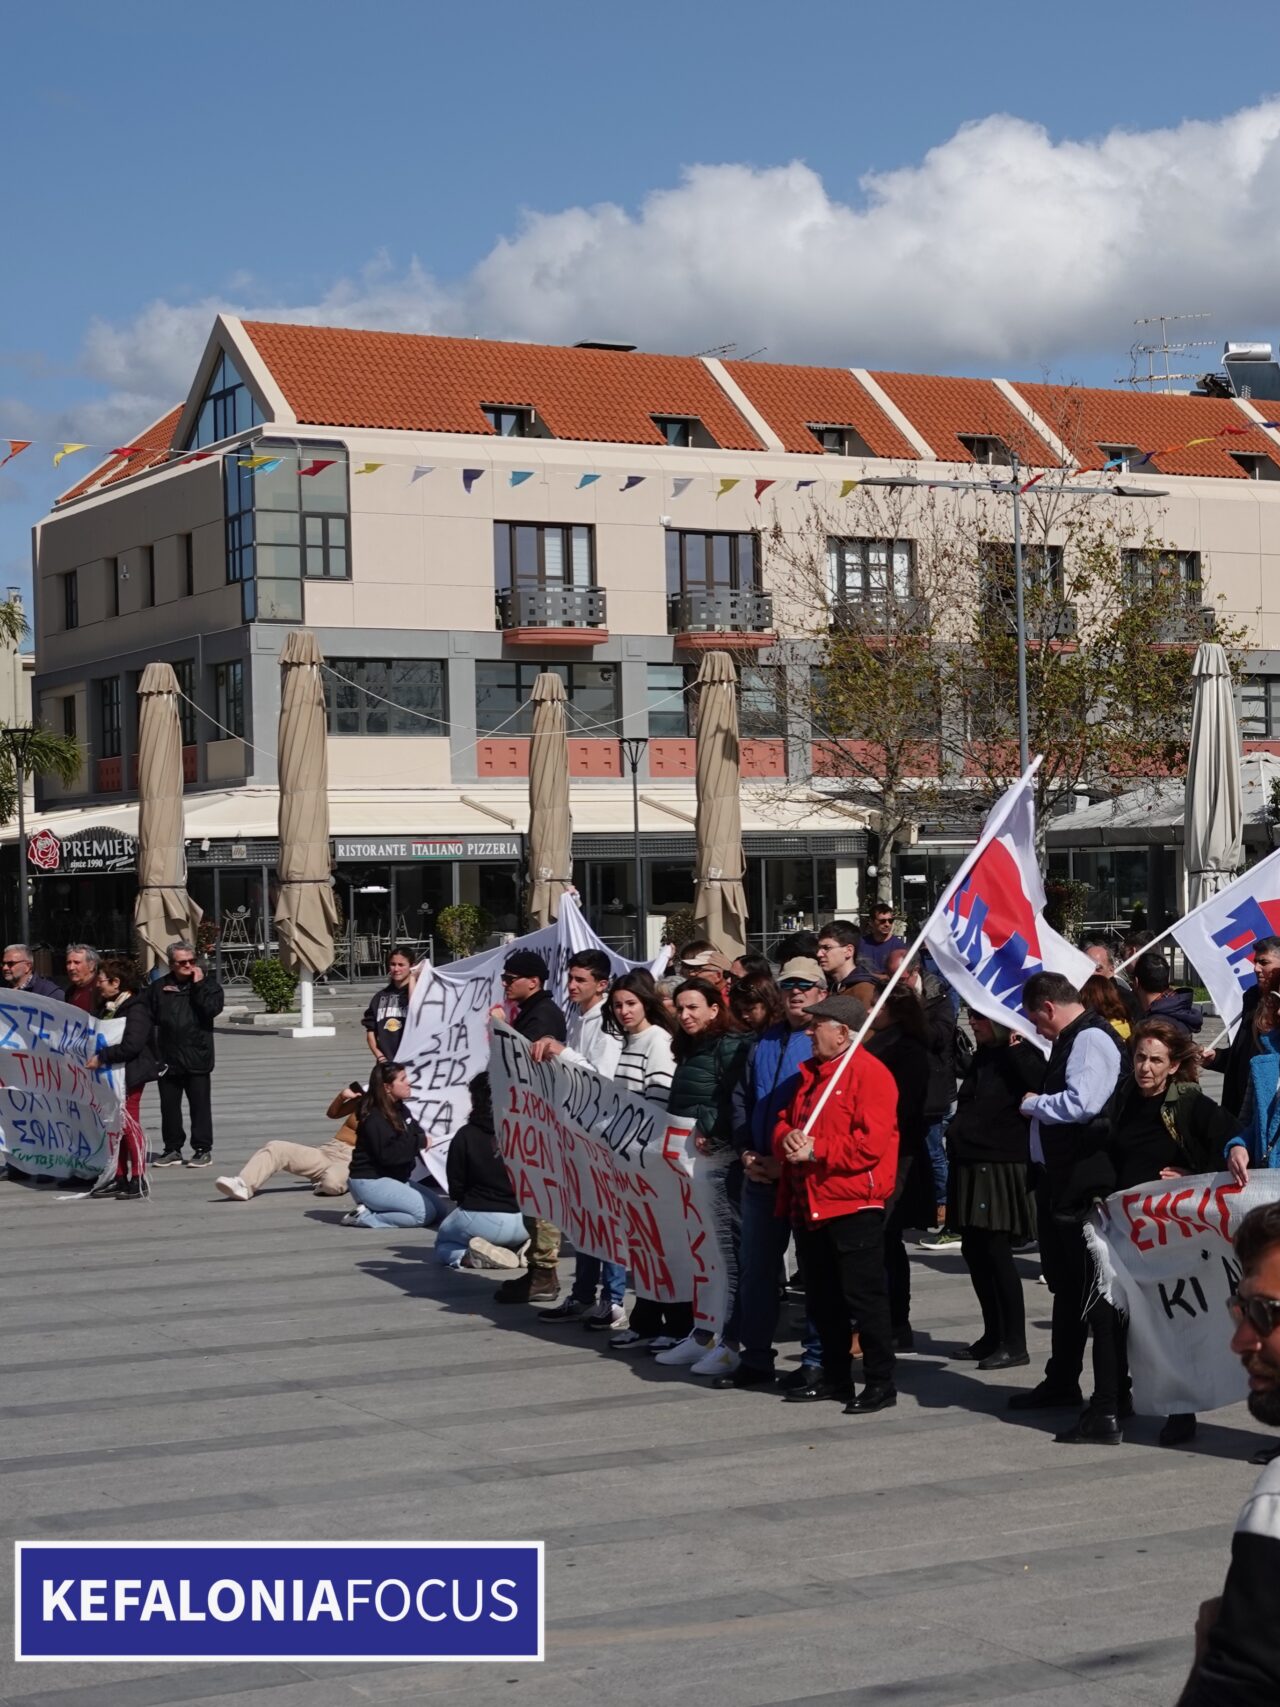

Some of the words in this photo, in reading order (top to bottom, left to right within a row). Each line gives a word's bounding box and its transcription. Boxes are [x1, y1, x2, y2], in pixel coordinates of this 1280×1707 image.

[61, 838, 135, 857] PREMIER
[338, 844, 407, 856] RISTORANTE
[411, 843, 463, 856] ITALIANO
[467, 843, 518, 855] PIZZERIA
[70, 860, 87, 868] since
[87, 858, 103, 868] 1990
[12, 1053, 62, 1094] ΤΗΝ
[509, 1086, 521, 1114] 1
[1158, 1276, 1209, 1320] ΚΙ
